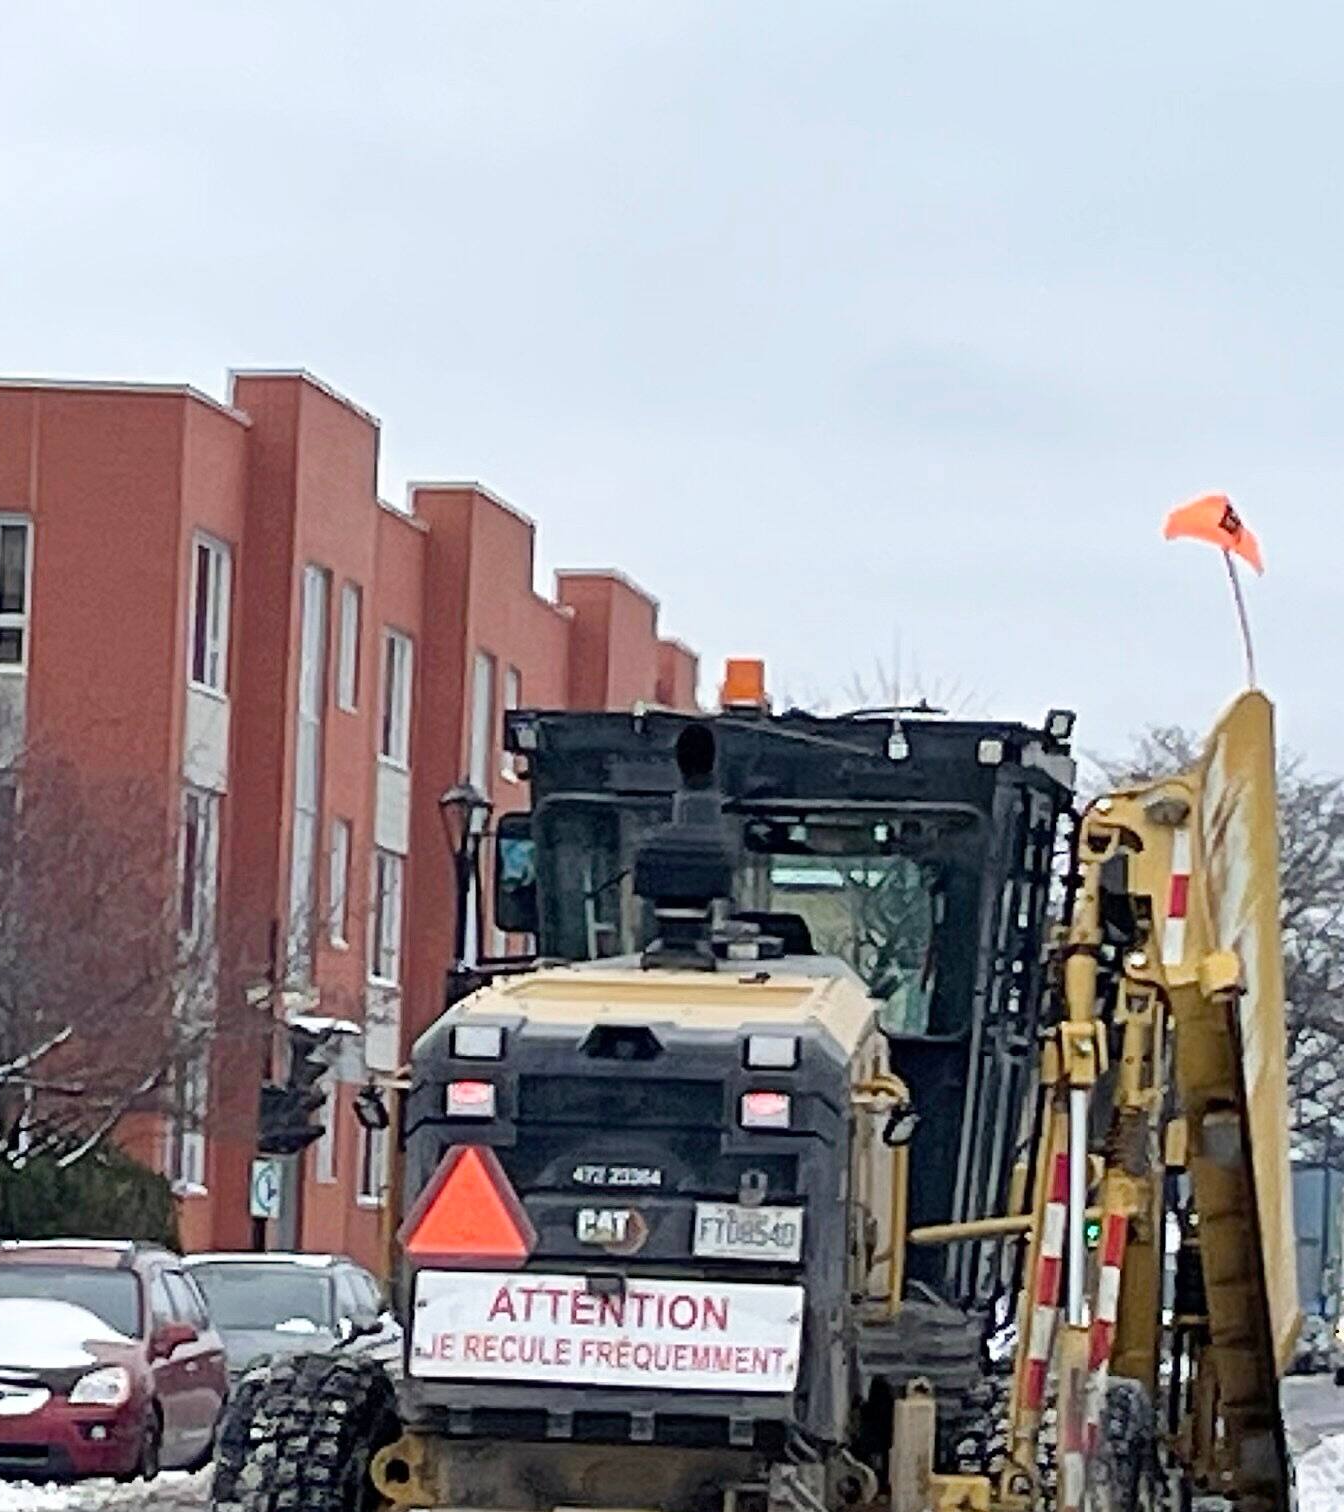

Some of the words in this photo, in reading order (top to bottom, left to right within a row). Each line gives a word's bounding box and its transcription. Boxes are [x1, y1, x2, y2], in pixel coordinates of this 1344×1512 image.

[577, 1208, 630, 1242] CAT
[488, 1286, 731, 1330] ATTENTION
[424, 1333, 459, 1361] JE
[463, 1335, 572, 1366] RECULE
[579, 1338, 787, 1376] FRÉQUEMMENT
